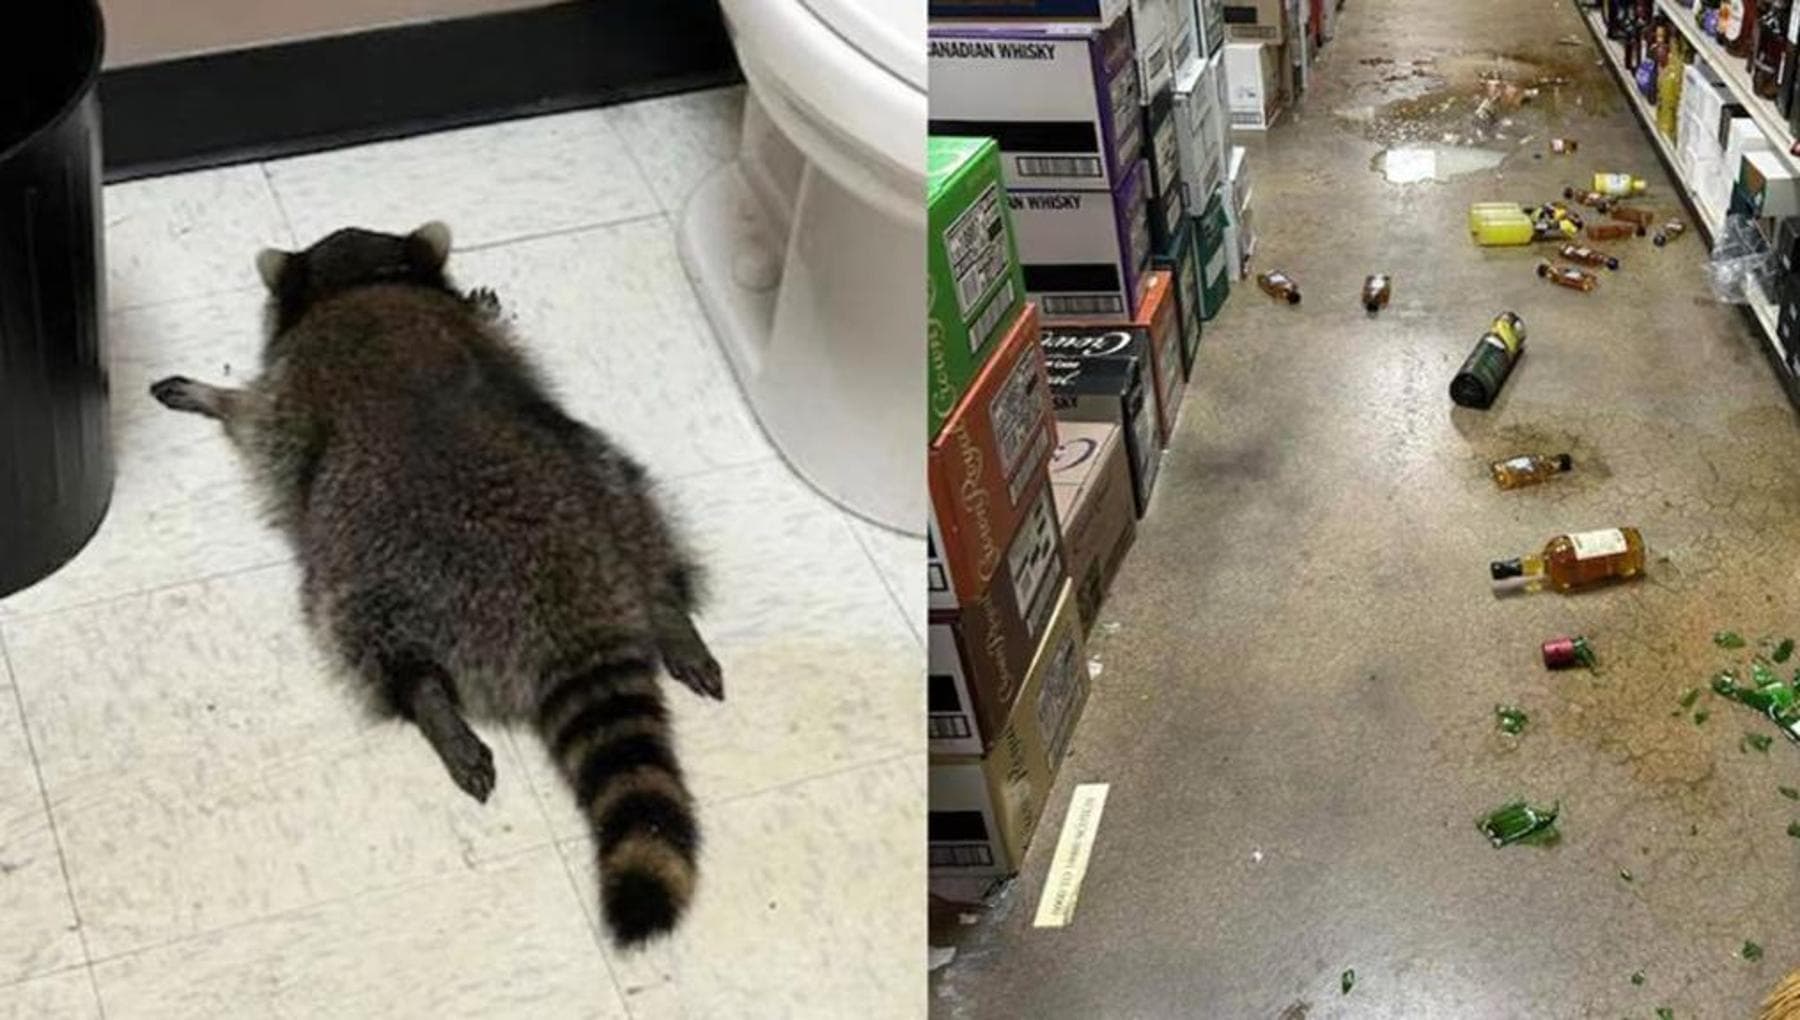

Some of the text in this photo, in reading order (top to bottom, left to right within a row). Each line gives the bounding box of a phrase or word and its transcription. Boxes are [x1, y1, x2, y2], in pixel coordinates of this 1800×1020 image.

[927, 41, 1056, 61] ANADIAN WHISKY
[1027, 194, 1082, 210] WHISKY
